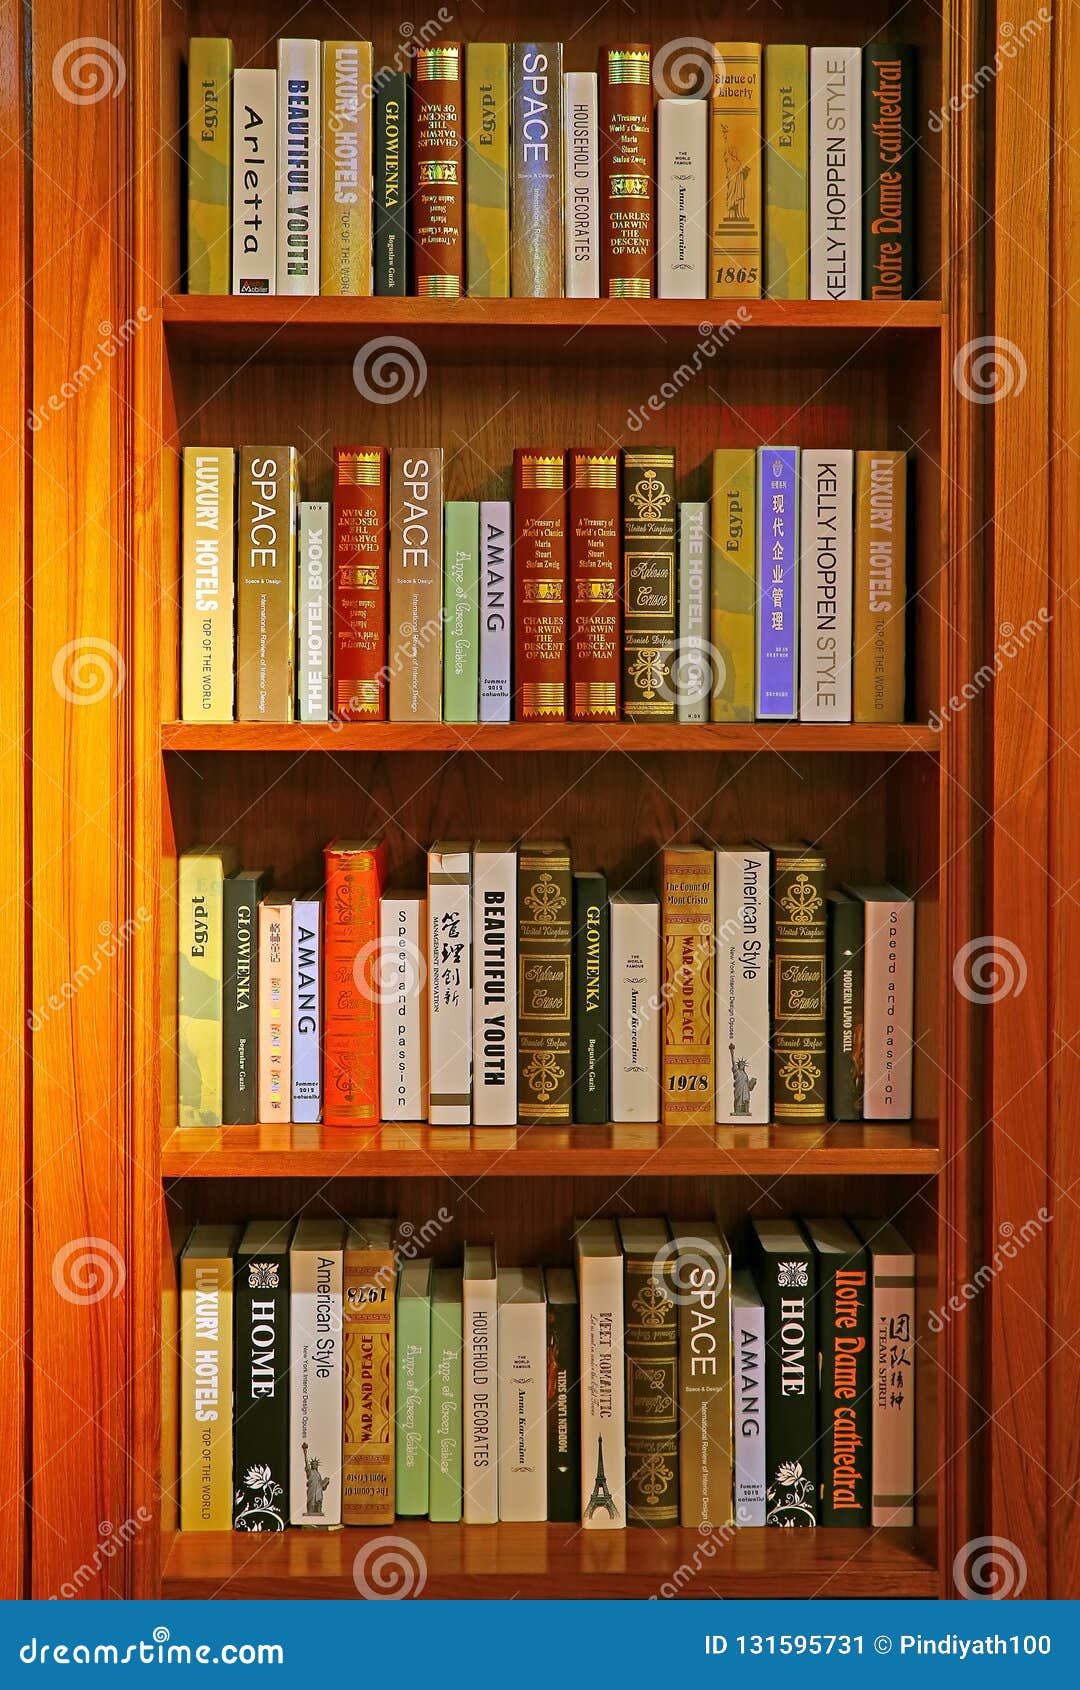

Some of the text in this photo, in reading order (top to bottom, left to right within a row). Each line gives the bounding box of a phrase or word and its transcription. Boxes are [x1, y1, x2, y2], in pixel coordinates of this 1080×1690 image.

[202, 80, 218, 142] Egypt
[480, 84, 496, 146] Egypt
[522, 53, 549, 163] SPACE
[715, 72, 745, 84] Statue
[718, 87, 753, 100] Liberty
[871, 60, 902, 164] cathedral
[335, 48, 358, 204] LUXURY HOTELS
[779, 86, 795, 147] Egypt
[244, 105, 265, 253] Arletta
[287, 80, 309, 276] BEAUTIFUL YOUTH
[574, 104, 590, 262] HOUSEHOLD DECORATES
[826, 60, 846, 300] KELLY HOPPEN STYLE
[871, 171, 902, 235] Dame
[610, 212, 650, 221] CHARLES
[611, 238, 650, 246] DESCENT
[612, 221, 648, 229] DARWIN
[613, 247, 647, 255] OF MAN
[621, 230, 640, 238] THE
[716, 267, 758, 284] 1865
[250, 458, 277, 568] SPACE
[402, 458, 429, 568] SPACE
[688, 511, 704, 554] THE
[726, 490, 744, 552] Egypt
[195, 456, 219, 710] LUXURY HOTELS TOP OF THE WORLD
[487, 523, 505, 632] AMANG
[688, 560, 703, 628] HOTEL
[771, 494, 785, 631] 现代企业管理
[816, 463, 837, 707] KELLY HOPPEN STYLE
[869, 459, 893, 710] LUXURY HOTELS TOP OF THE WORLD
[308, 528, 322, 714] THE HOTEL BOOK
[524, 617, 563, 625] CHARLES
[524, 642, 563, 651] DESCENT
[526, 625, 561, 634] DARWIN
[536, 634, 552, 642] THE
[540, 651, 560, 659] MAN
[576, 617, 616, 625] CHARLES
[576, 642, 616, 651] DESCENT
[578, 625, 614, 634] DARWIN
[588, 634, 605, 642] THE
[592, 651, 612, 659] MAN
[666, 882, 698, 892] The Count
[667, 895, 708, 905] Mont Cristo
[742, 858, 762, 980] American Style
[191, 896, 208, 958] Egypt
[441, 911, 465, 1008] 管理创新
[297, 926, 316, 1034] AMANG
[398, 910, 406, 1107] Speed and passion
[483, 891, 505, 1086] BEAUTIFUL YOUTH
[682, 936, 694, 1043] WAR AND PEACE
[843, 969, 853, 1004] MODERN
[884, 911, 897, 1105] Speed and passion
[843, 1029, 852, 1053] SKILL
[668, 1074, 708, 1092] 1978
[312, 1256, 335, 1379] American Style
[347, 1287, 387, 1303] 1978
[690, 1268, 716, 1375] SPACE
[251, 1299, 275, 1399] HOME
[558, 1370, 567, 1393] SKILL
[599, 1312, 612, 1418] MEET ROMANTIC
[740, 1330, 760, 1437] AMANG
[781, 1297, 805, 1396] HOME
[878, 1326, 887, 1409] TEAM SPIRIT
[889, 1313, 911, 1411] 团队精神
[195, 1268, 218, 1520] LUXURY HOTELS TOP OF THE WORLD
[361, 1335, 373, 1442] WAR AND PEACE
[472, 1311, 488, 1467] HOUSEHOLD DECORATES
[833, 1270, 866, 1510] Notre Dame cathedral
[558, 1418, 567, 1452] MODERN
